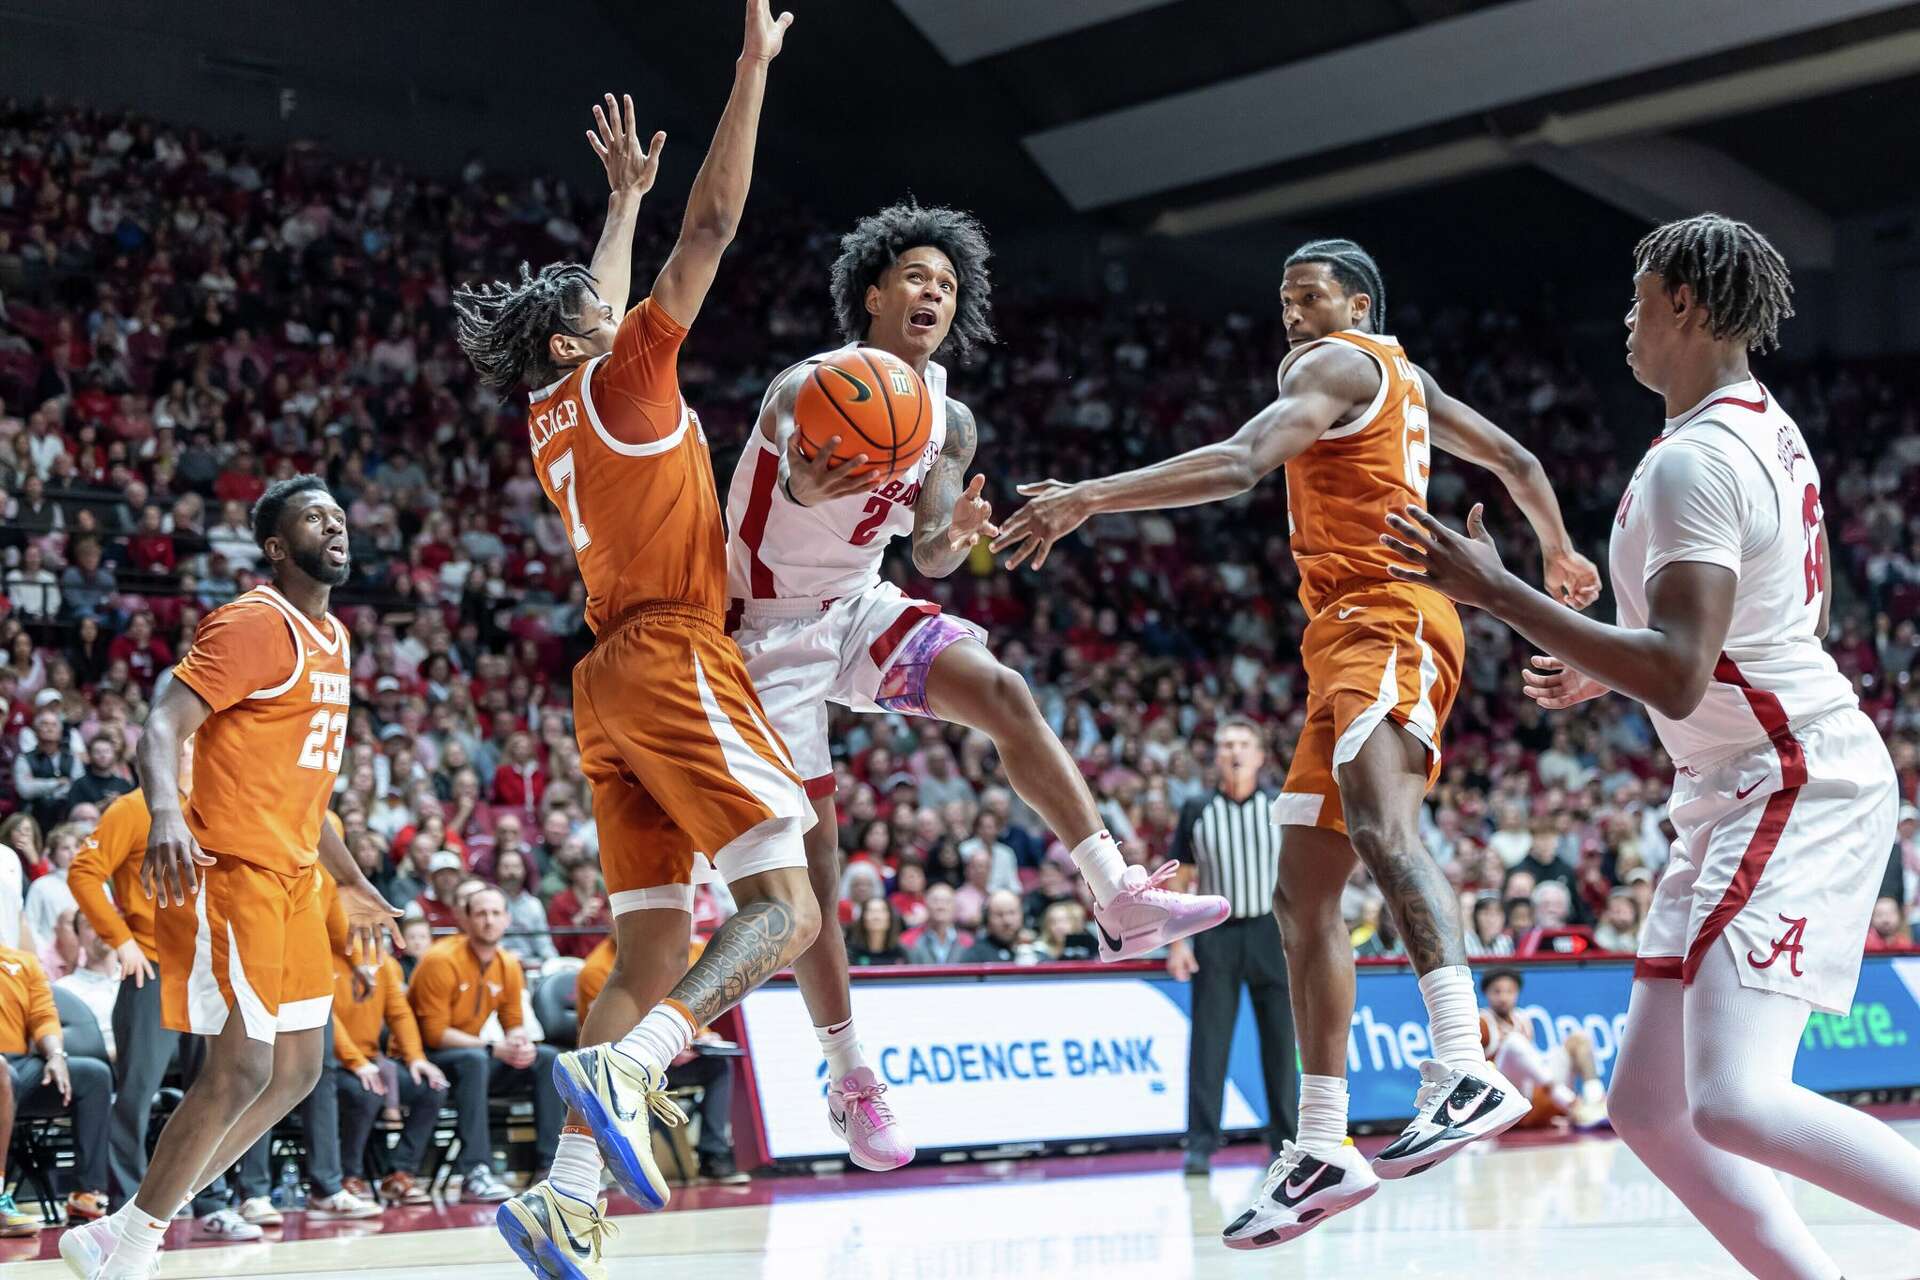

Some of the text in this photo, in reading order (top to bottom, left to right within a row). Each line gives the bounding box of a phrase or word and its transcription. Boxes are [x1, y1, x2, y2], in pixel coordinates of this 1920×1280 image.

[549, 447, 591, 552] 7
[850, 495, 893, 547] 2
[297, 710, 347, 773] 23
[1747, 912, 1808, 977] A
[880, 1036, 1161, 1086] CADENCE BANK
